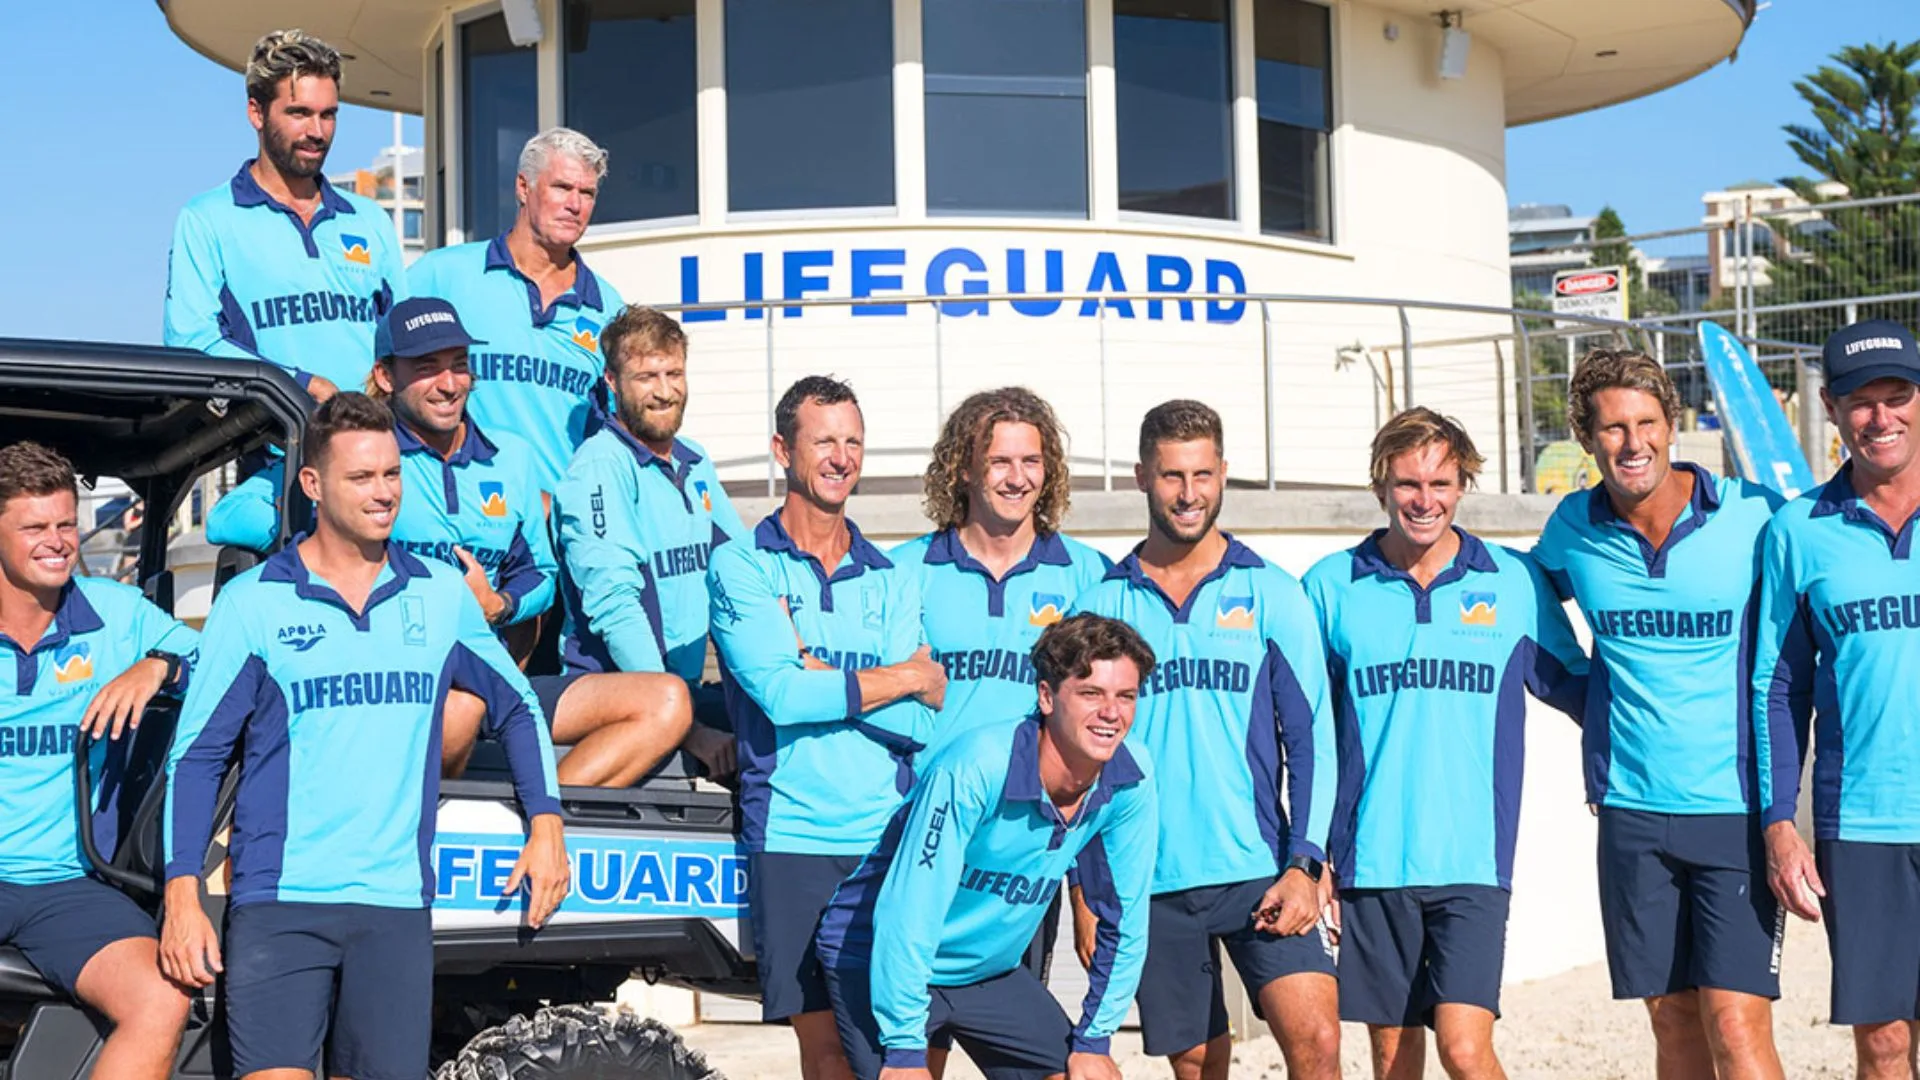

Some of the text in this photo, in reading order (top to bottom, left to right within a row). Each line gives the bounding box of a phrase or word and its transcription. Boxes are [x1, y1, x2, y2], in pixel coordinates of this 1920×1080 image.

[680, 247, 1247, 324] LIFEGUARD
[251, 290, 374, 330] LIFEGUAR
[404, 312, 456, 331] LIFEGUARD
[1845, 337, 1904, 356] LIFEGUARD
[469, 353, 593, 396] LIFEGUARD
[653, 542, 711, 579] LIFEGU
[277, 623, 327, 639] APOLA
[1587, 609, 1734, 639] LIFEGUARD
[1823, 594, 1920, 638] LIFEGU
[290, 670, 434, 715] LIFEGUARD
[1354, 657, 1496, 699] LIFEGUARD
[917, 800, 950, 870] XCEL
